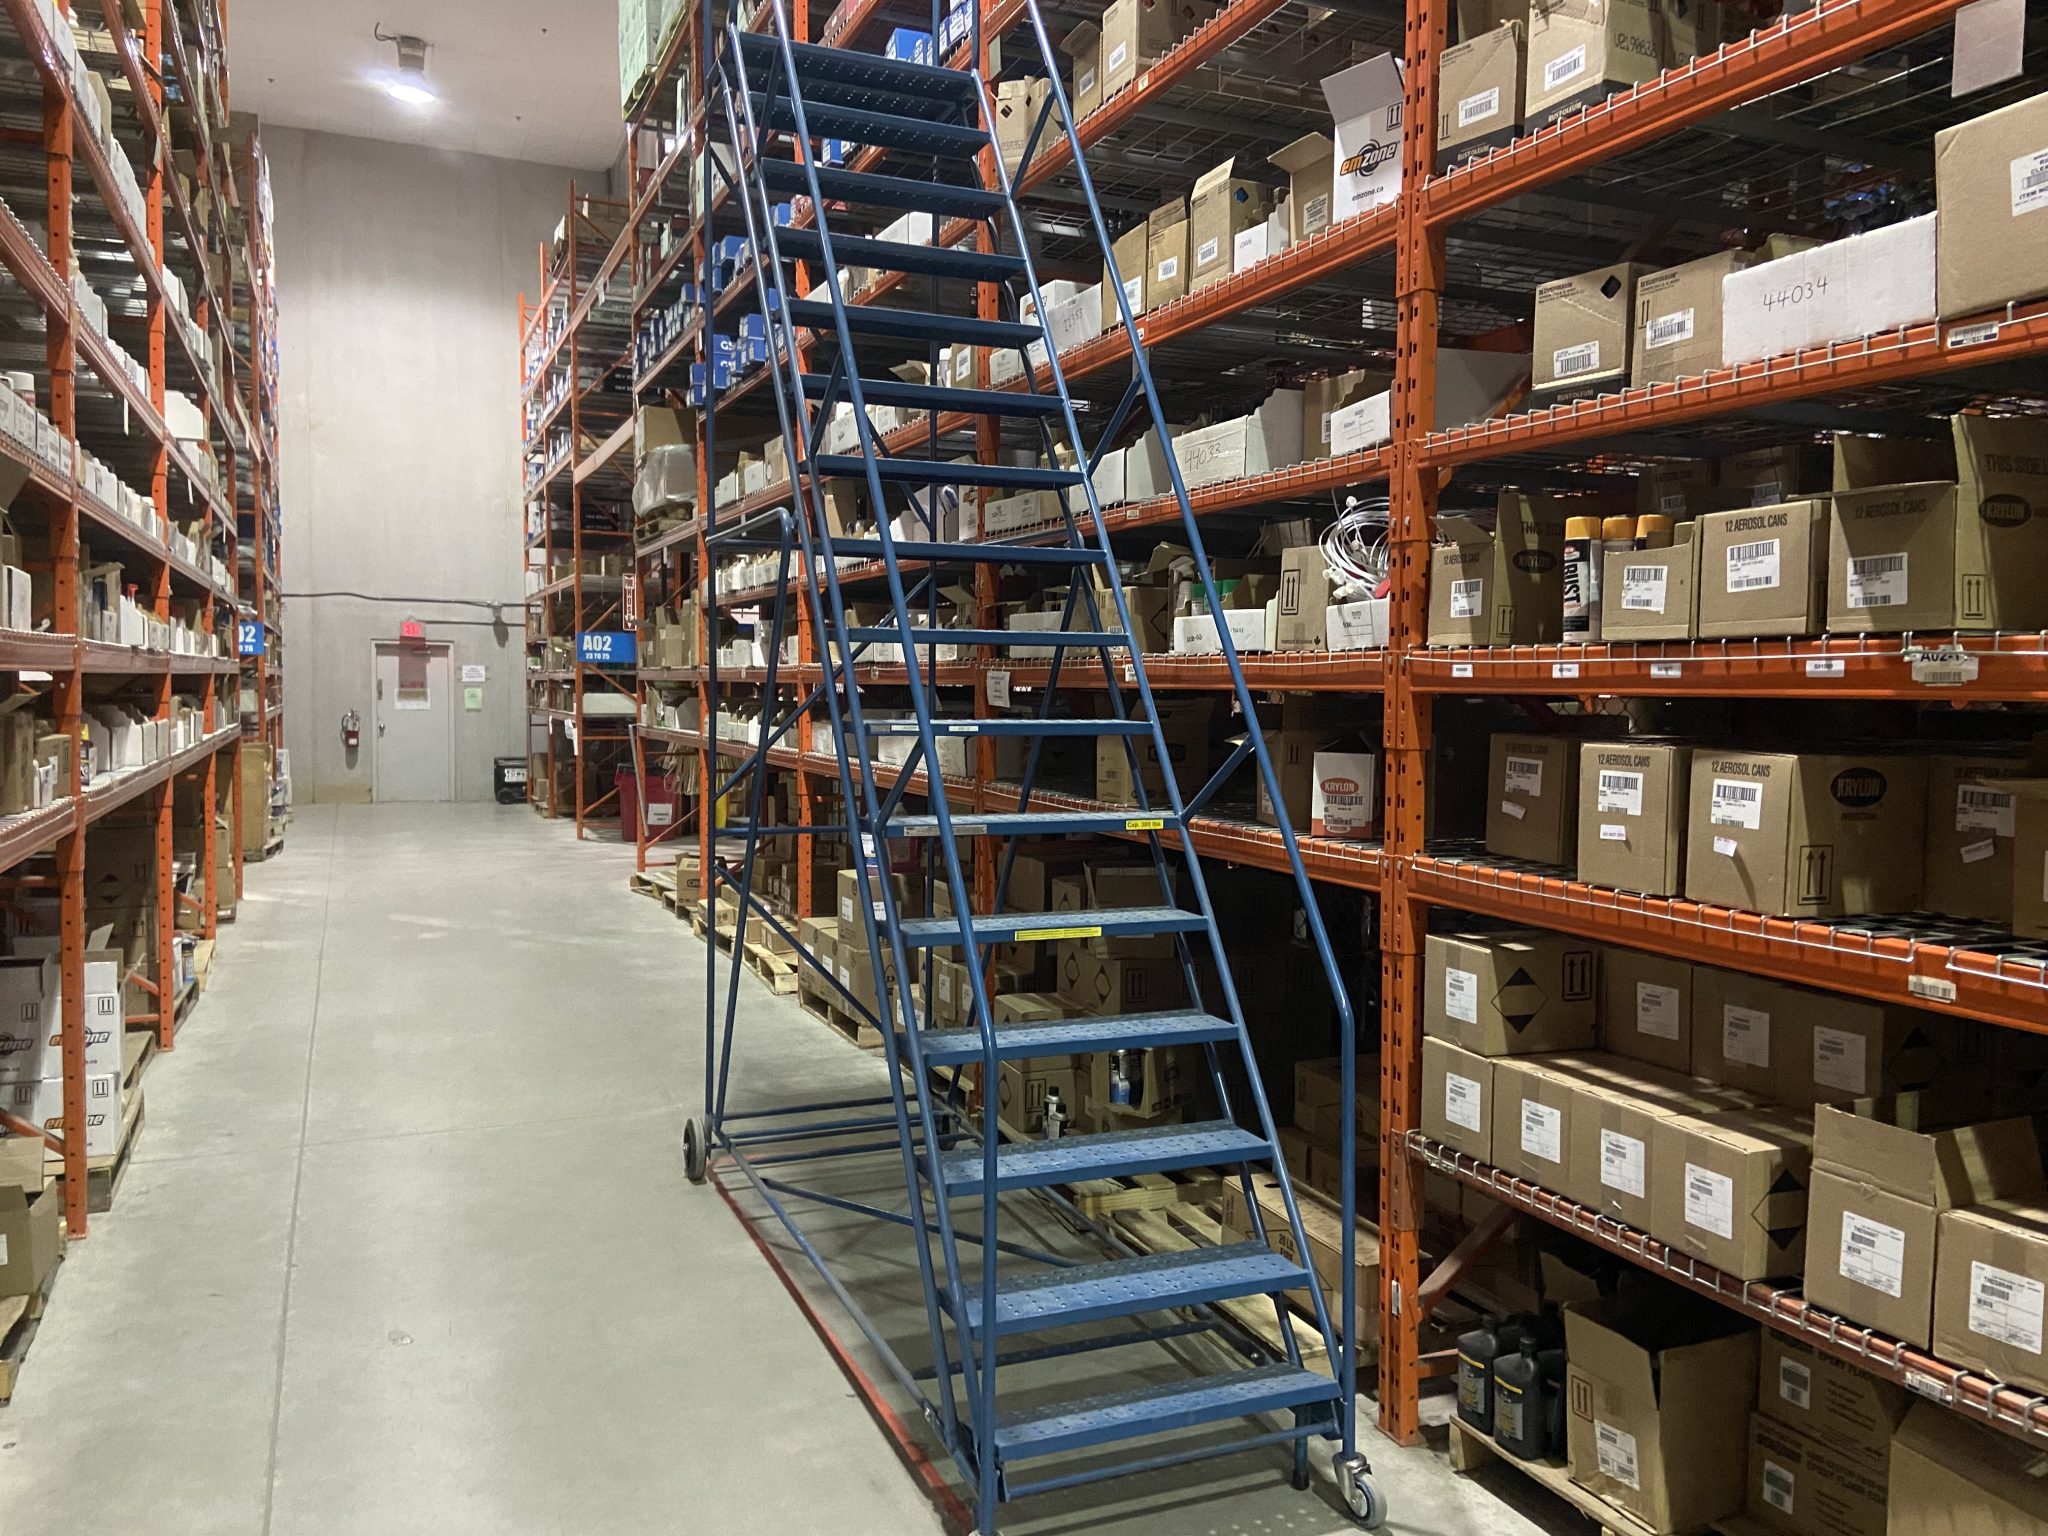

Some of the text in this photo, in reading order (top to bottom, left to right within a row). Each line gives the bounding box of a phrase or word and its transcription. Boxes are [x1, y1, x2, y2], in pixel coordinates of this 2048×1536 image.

[1340, 141, 1398, 176] emzone
[1352, 186, 1384, 201] emzone.ca
[1763, 276, 1828, 312] 44034
[1184, 442, 1221, 473] 44033
[1725, 513, 1788, 533] 12 AEROSOL CANS
[583, 635, 612, 651] A02
[594, 652, 601, 660] TO
[1598, 754, 1650, 768] 12 AEROSOL CANS
[1711, 761, 1771, 777] 12 AEROSOL CANS
[1325, 781, 1355, 792] KRYLON
[1838, 777, 1880, 798] KRYLON
